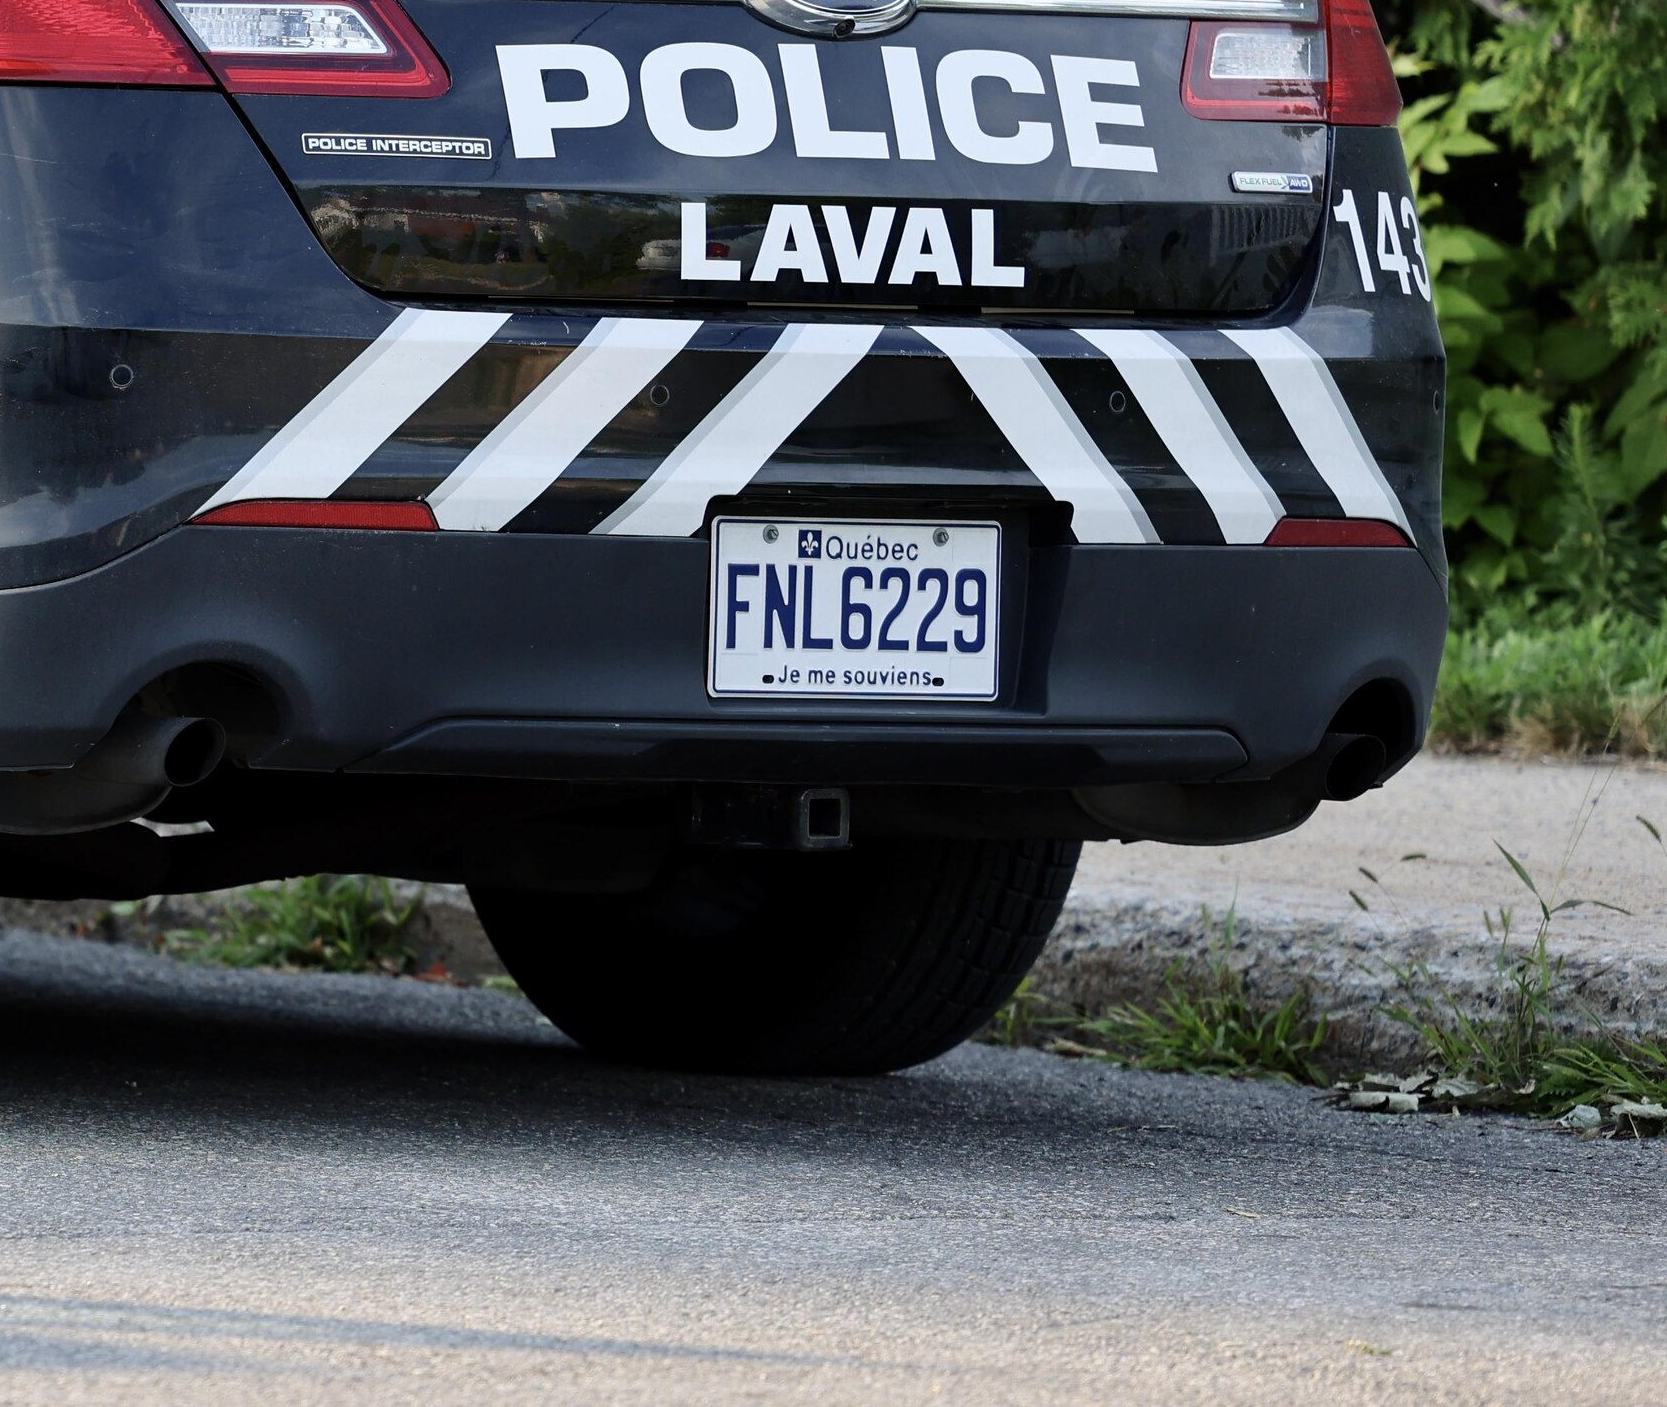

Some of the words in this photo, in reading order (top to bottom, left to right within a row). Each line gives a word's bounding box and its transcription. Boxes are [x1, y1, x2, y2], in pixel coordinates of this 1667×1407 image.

[496, 41, 1157, 174] POLICE
[308, 138, 367, 151] POLICE
[372, 139, 485, 155] INTERCEPTOR
[1239, 177, 1261, 186] FLEX
[1261, 178, 1282, 187] FUEL
[1290, 178, 1308, 187] AWD
[680, 202, 1024, 288] LAVAL
[825, 534, 919, 561] Québec
[725, 563, 987, 653] FNL6229
[778, 665, 800, 684] Je
[808, 667, 836, 684] me
[843, 665, 932, 686] souviens
